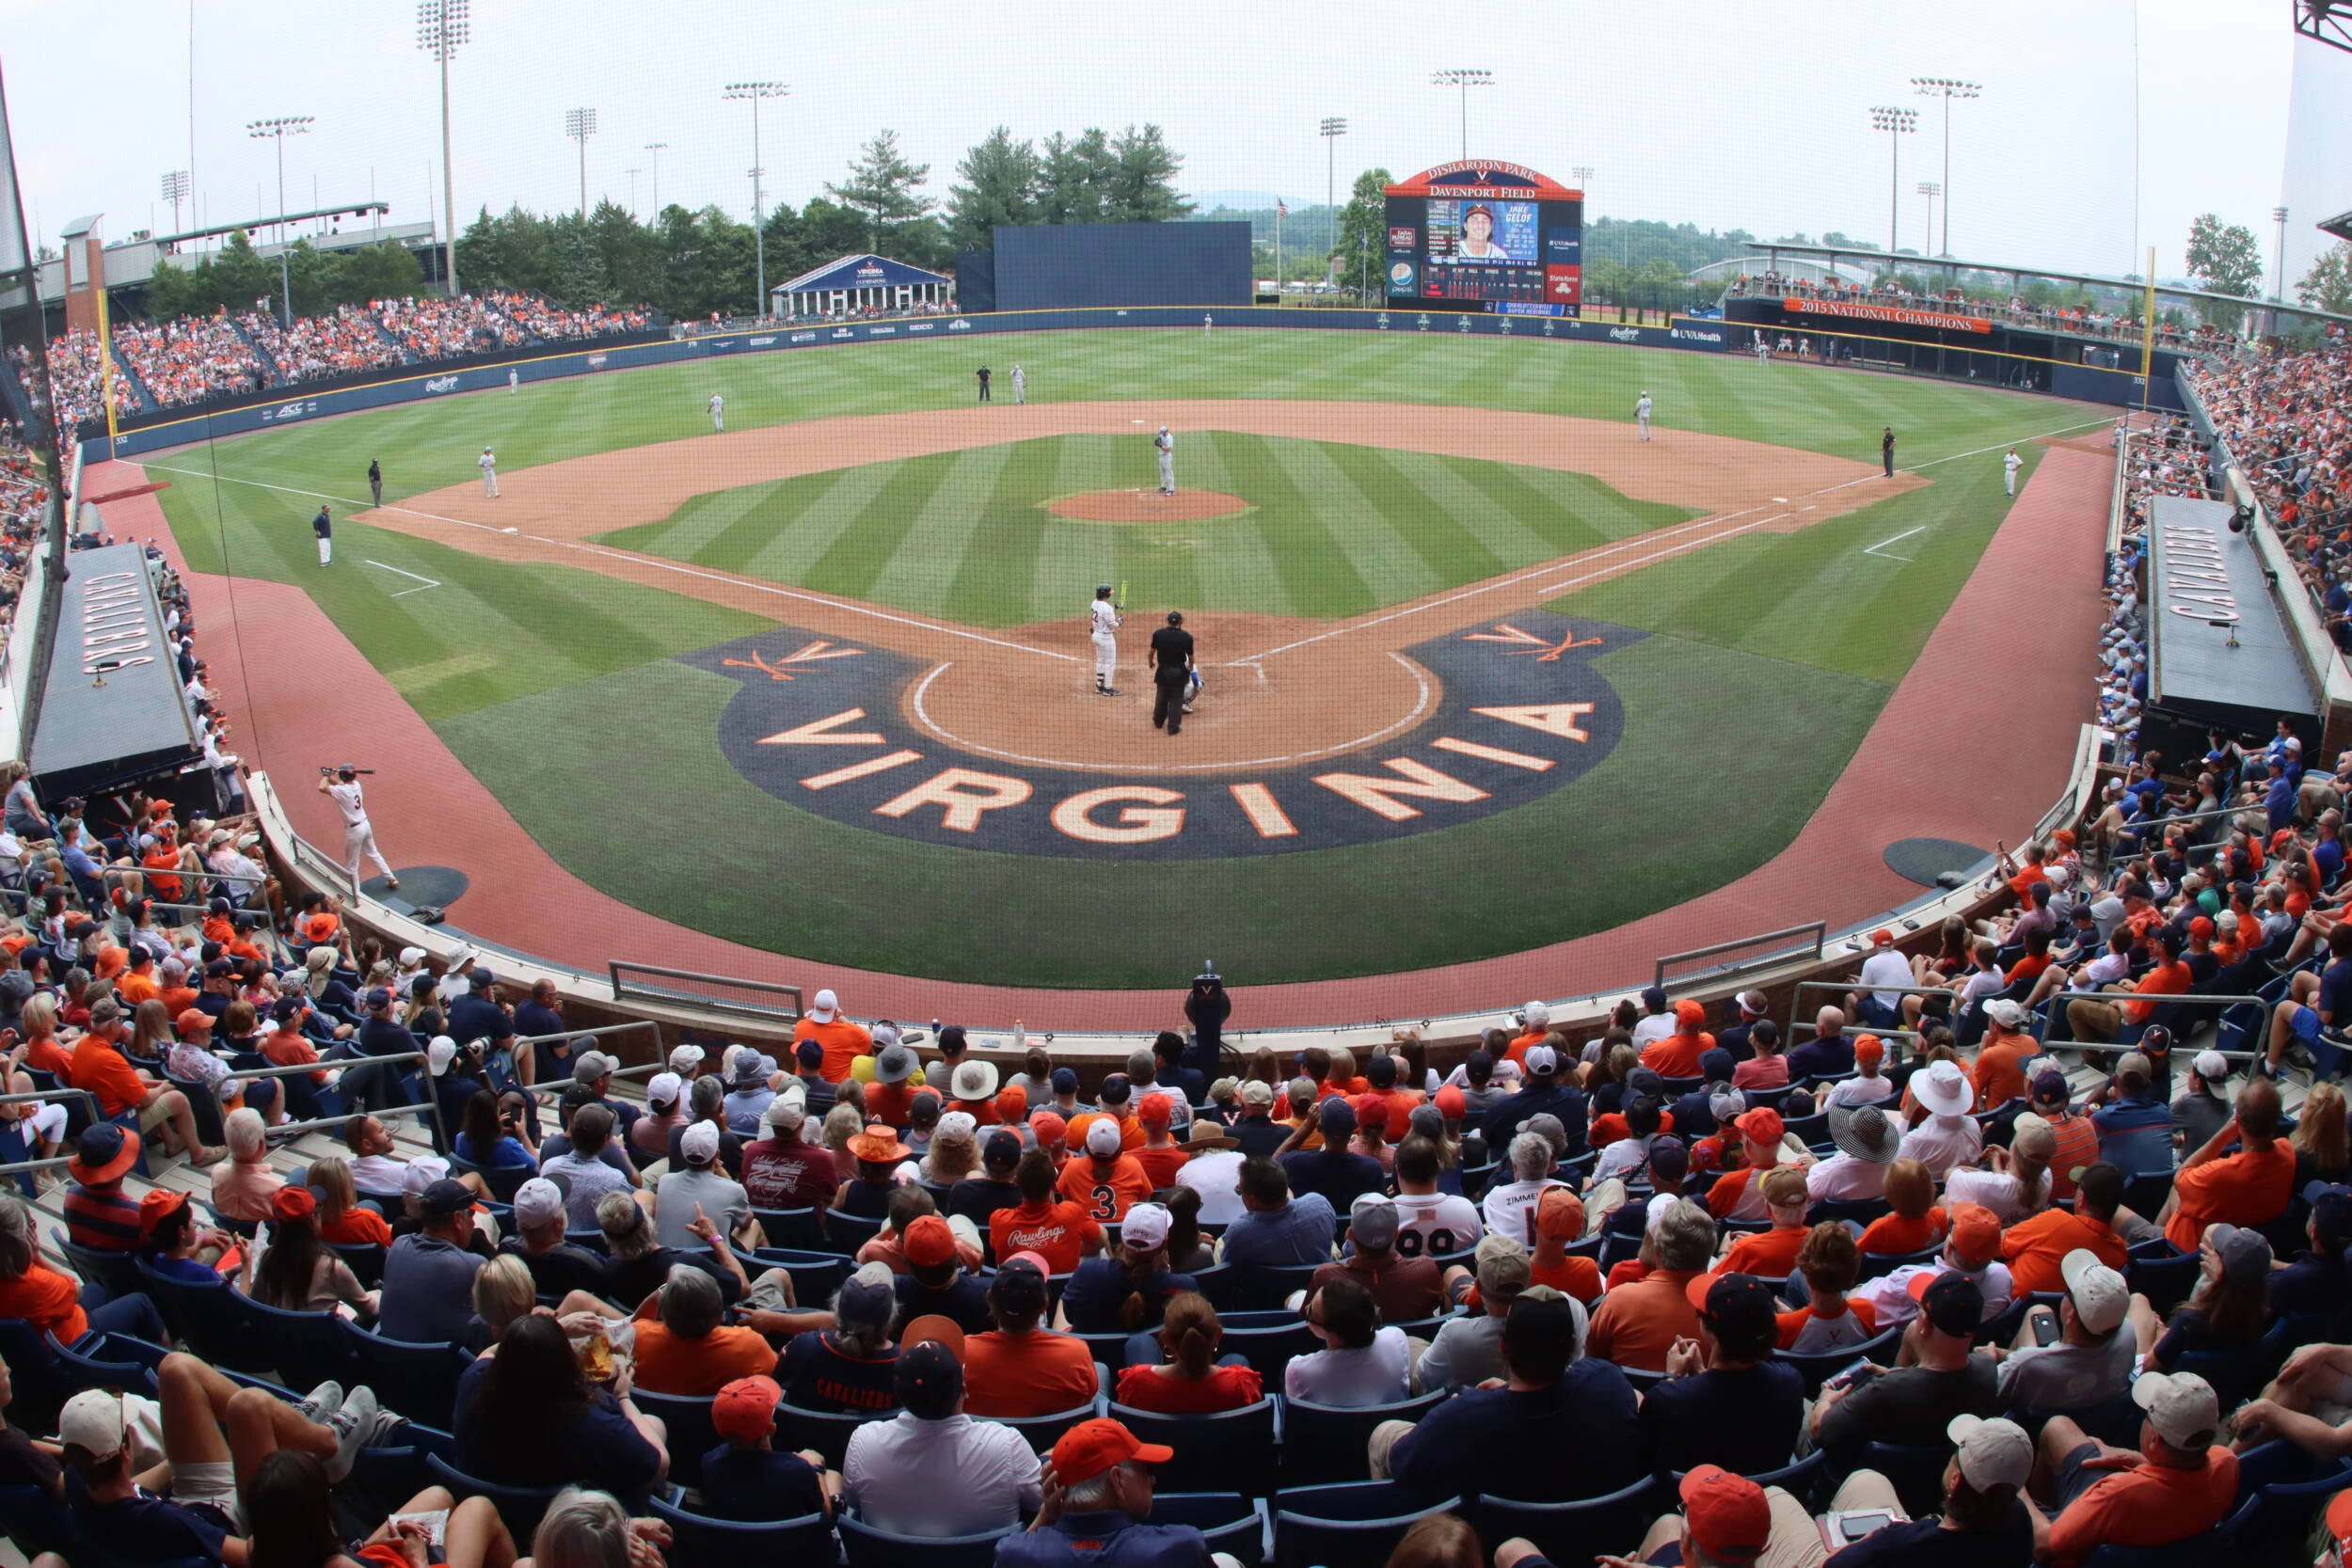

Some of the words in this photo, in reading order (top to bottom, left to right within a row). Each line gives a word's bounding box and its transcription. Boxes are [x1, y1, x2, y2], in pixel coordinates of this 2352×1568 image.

[1427, 160, 1502, 180] DISHAROON
[1505, 163, 1537, 182] PARK
[1429, 185, 1497, 198] DAVENPORT
[1501, 187, 1535, 199] FIELD
[1509, 205, 1529, 214] JAKE
[1505, 213, 1533, 223] GELOF
[1800, 300, 1827, 313] 2015
[1830, 302, 1891, 322] NATIONAL
[1895, 310, 1972, 331] CHAMPIONS
[1610, 327, 1640, 340] Rawlings
[425, 376, 459, 391] Rawlings
[276, 403, 304, 418] ACC
[2163, 525, 2241, 622] CAVALIERS
[755, 702, 1596, 844] VIRGINIA
[354, 794, 361, 810] 3
[1090, 1184, 1118, 1221] 3
[1505, 1192, 1538, 1206] ZIMME
[1008, 1226, 1067, 1247] Rawlings
[816, 1376, 895, 1409] CAVALIERS
